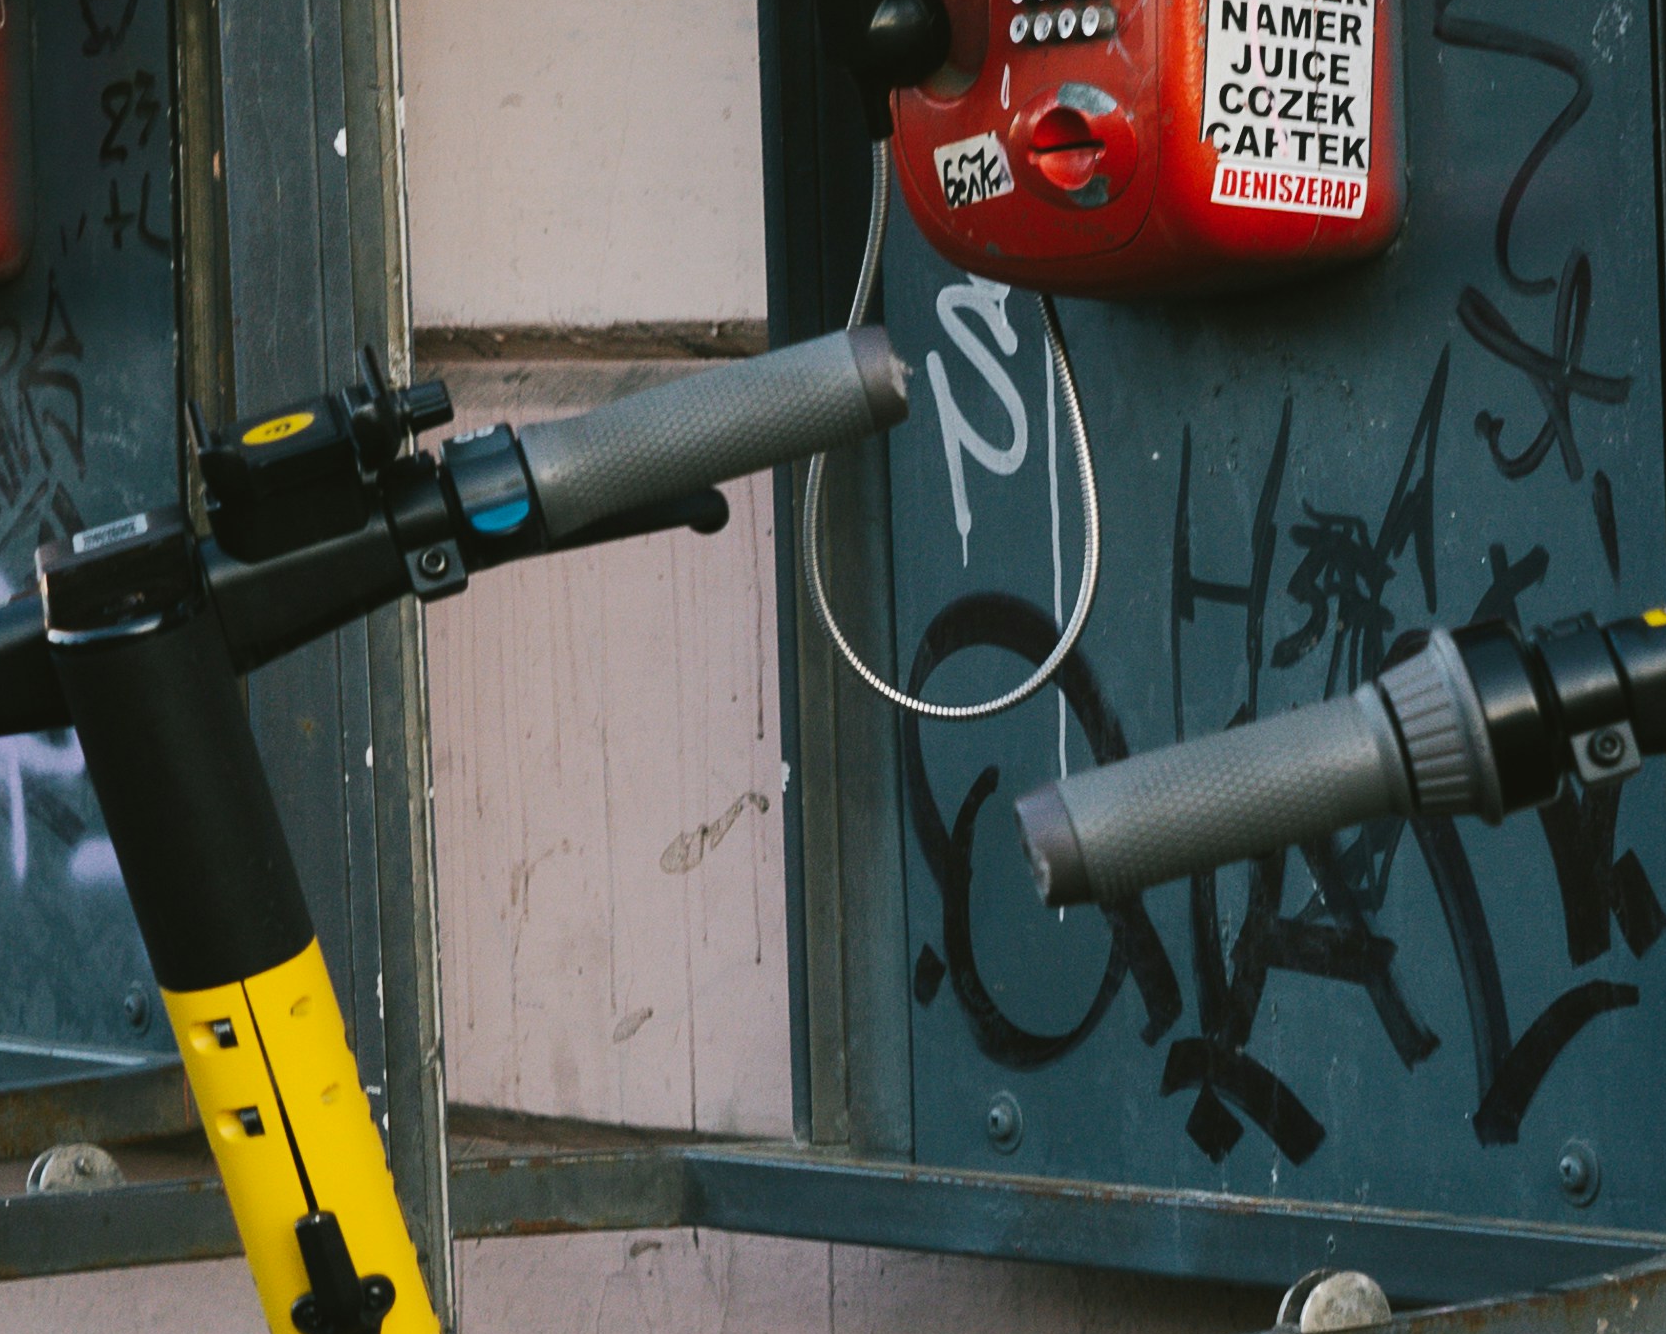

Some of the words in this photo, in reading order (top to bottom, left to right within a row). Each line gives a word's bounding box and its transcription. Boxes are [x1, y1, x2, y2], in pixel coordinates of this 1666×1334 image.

[1221, 0, 1362, 46] NAMER
[1231, 44, 1351, 87] JUICE
[1219, 83, 1355, 127] COZEK
[1220, 168, 1362, 211] DENISZERAP
